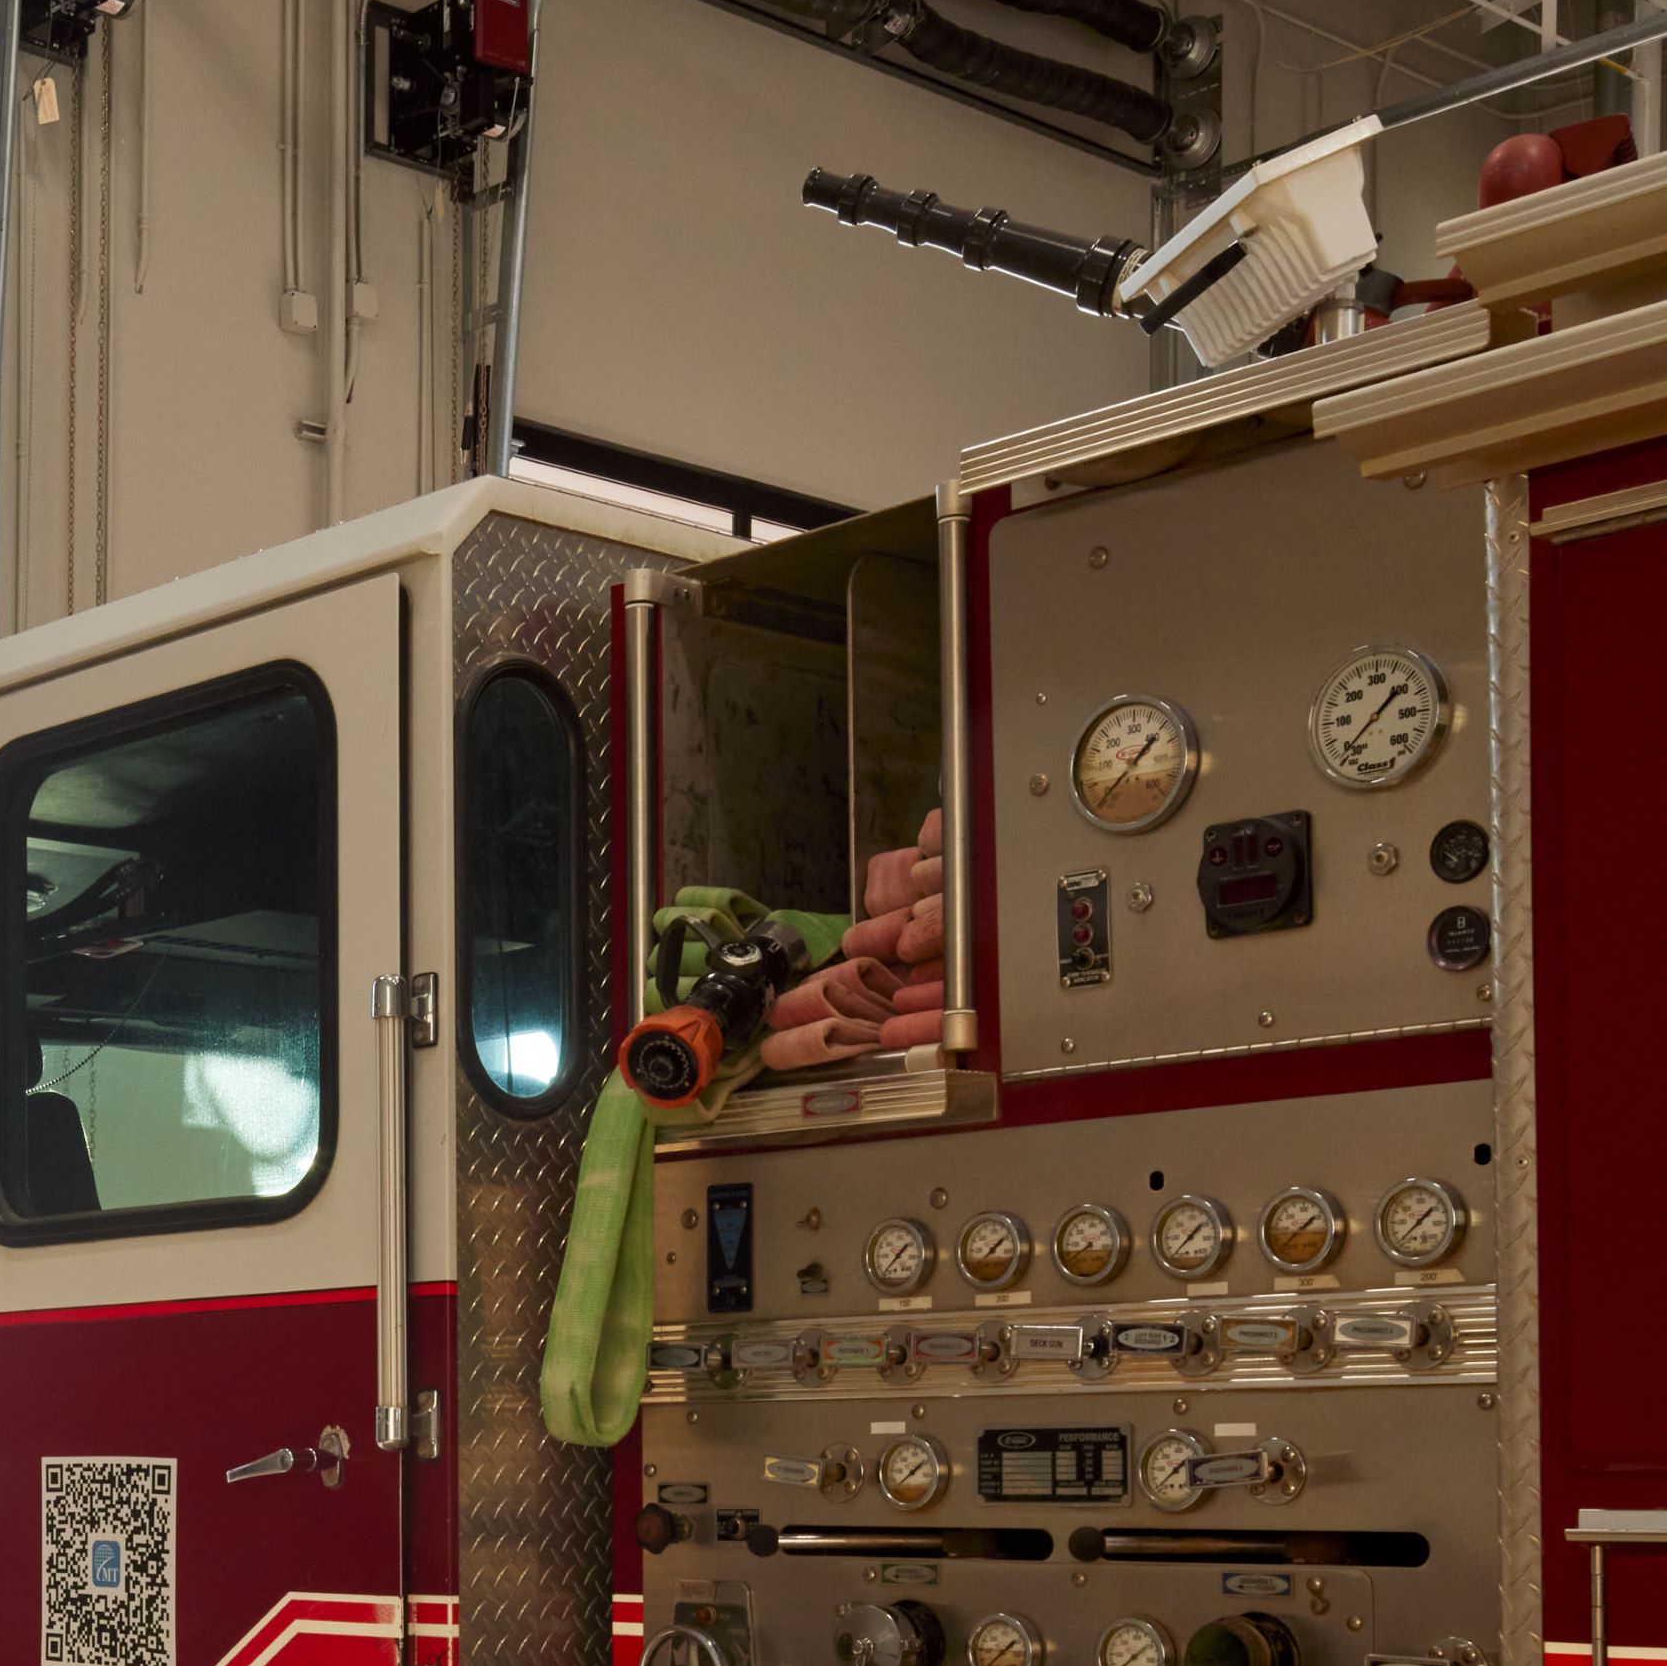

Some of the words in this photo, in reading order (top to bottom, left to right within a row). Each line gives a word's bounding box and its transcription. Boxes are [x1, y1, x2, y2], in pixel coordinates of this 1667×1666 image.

[1367, 673, 1386, 686] 300
[1345, 690, 1363, 703] 200
[1398, 706, 1417, 720] 500
[1336, 715, 1351, 727] 100
[1127, 723, 1142, 735] 300
[1106, 737, 1121, 749] 200
[1390, 733, 1409, 746] 600
[1099, 760, 1113, 771] 100
[1030, 1339, 1047, 1348] DECK
[1058, 1432, 1119, 1443] PERFORMANCE
